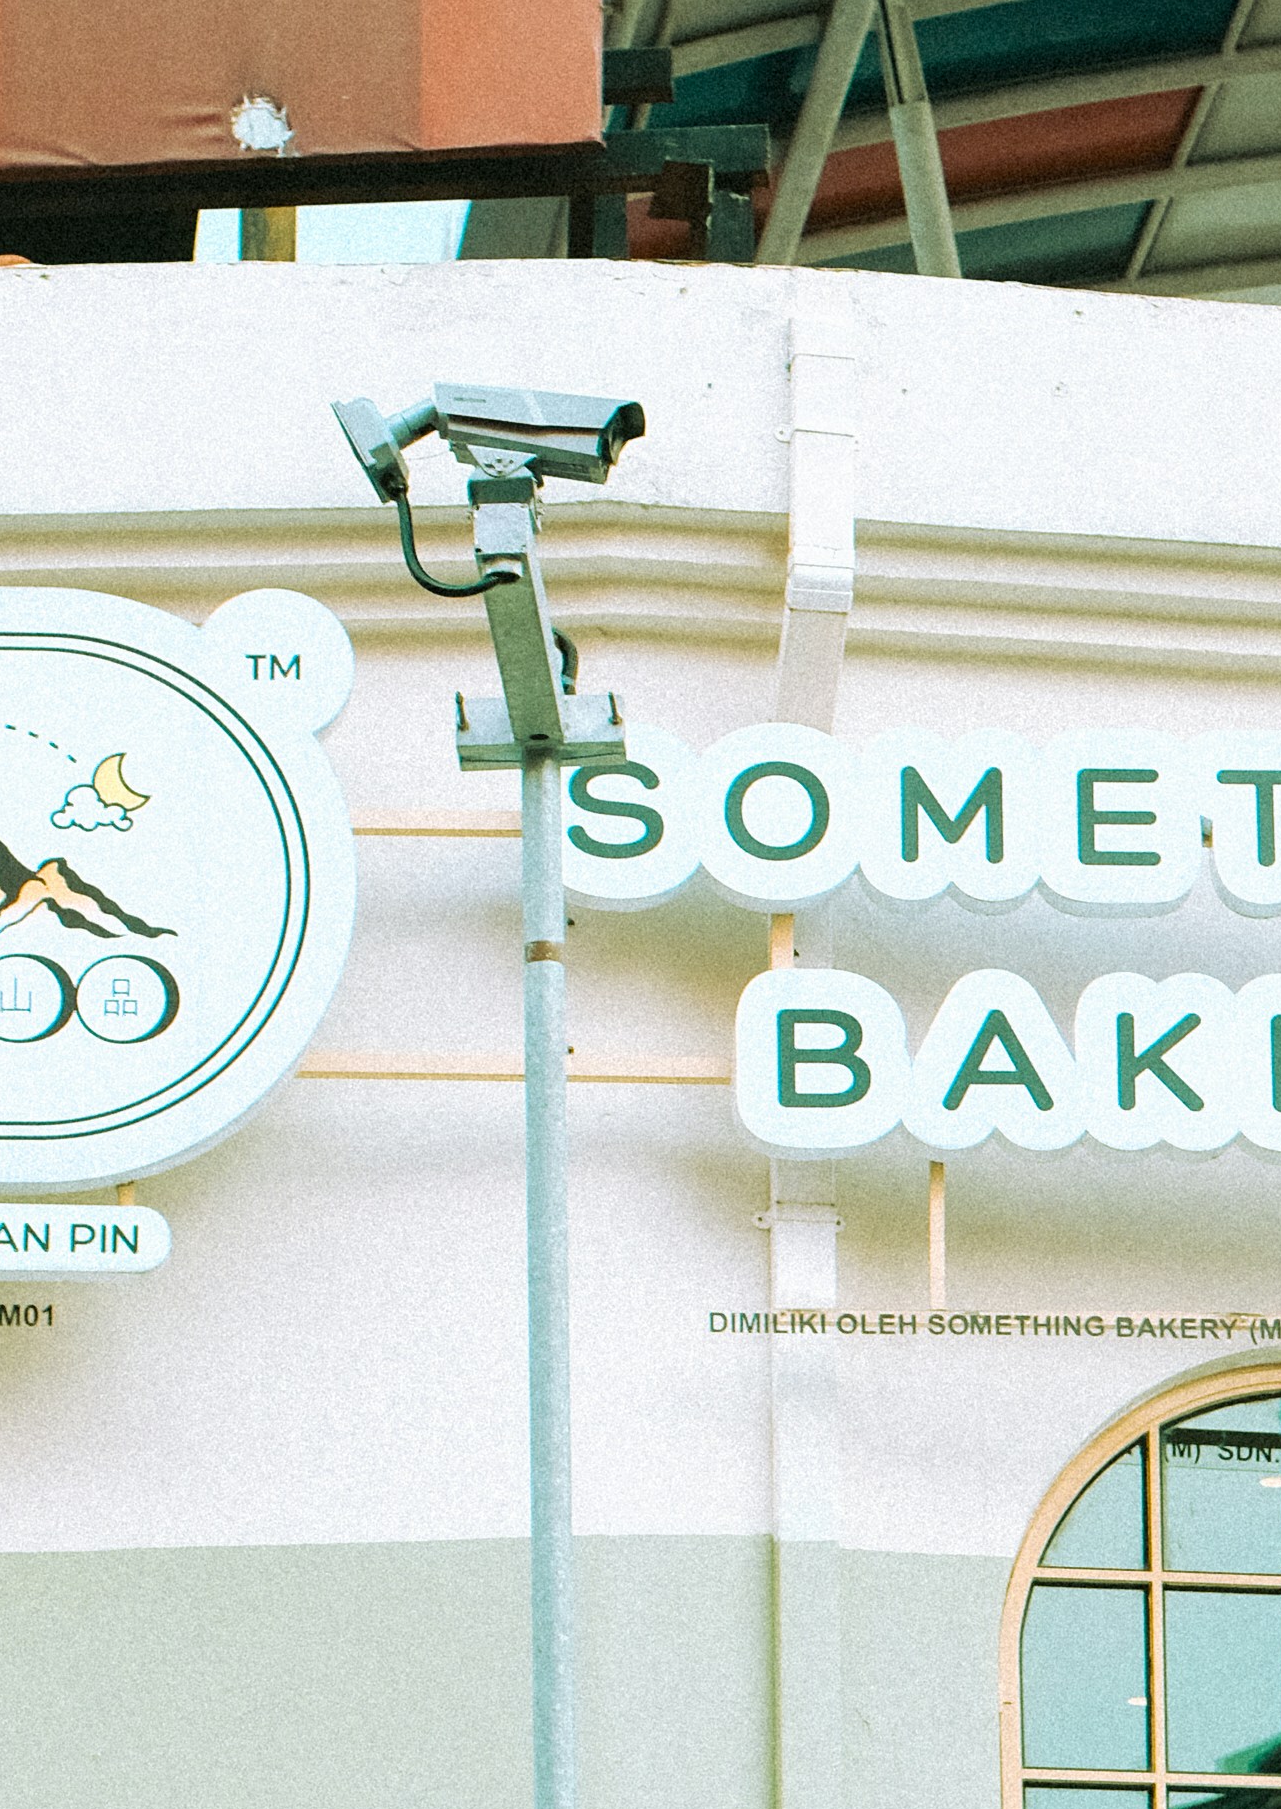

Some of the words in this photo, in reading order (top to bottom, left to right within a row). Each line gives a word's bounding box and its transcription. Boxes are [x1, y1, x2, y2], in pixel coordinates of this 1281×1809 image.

[246, 653, 303, 682] TM
[71, 1222, 139, 1255] PIN
[709, 1311, 825, 1334] DIMILIKI
[836, 1312, 918, 1335] OLEH
[926, 1313, 1105, 1338] SOMETHING
[1116, 1316, 1235, 1341] BAKERY
